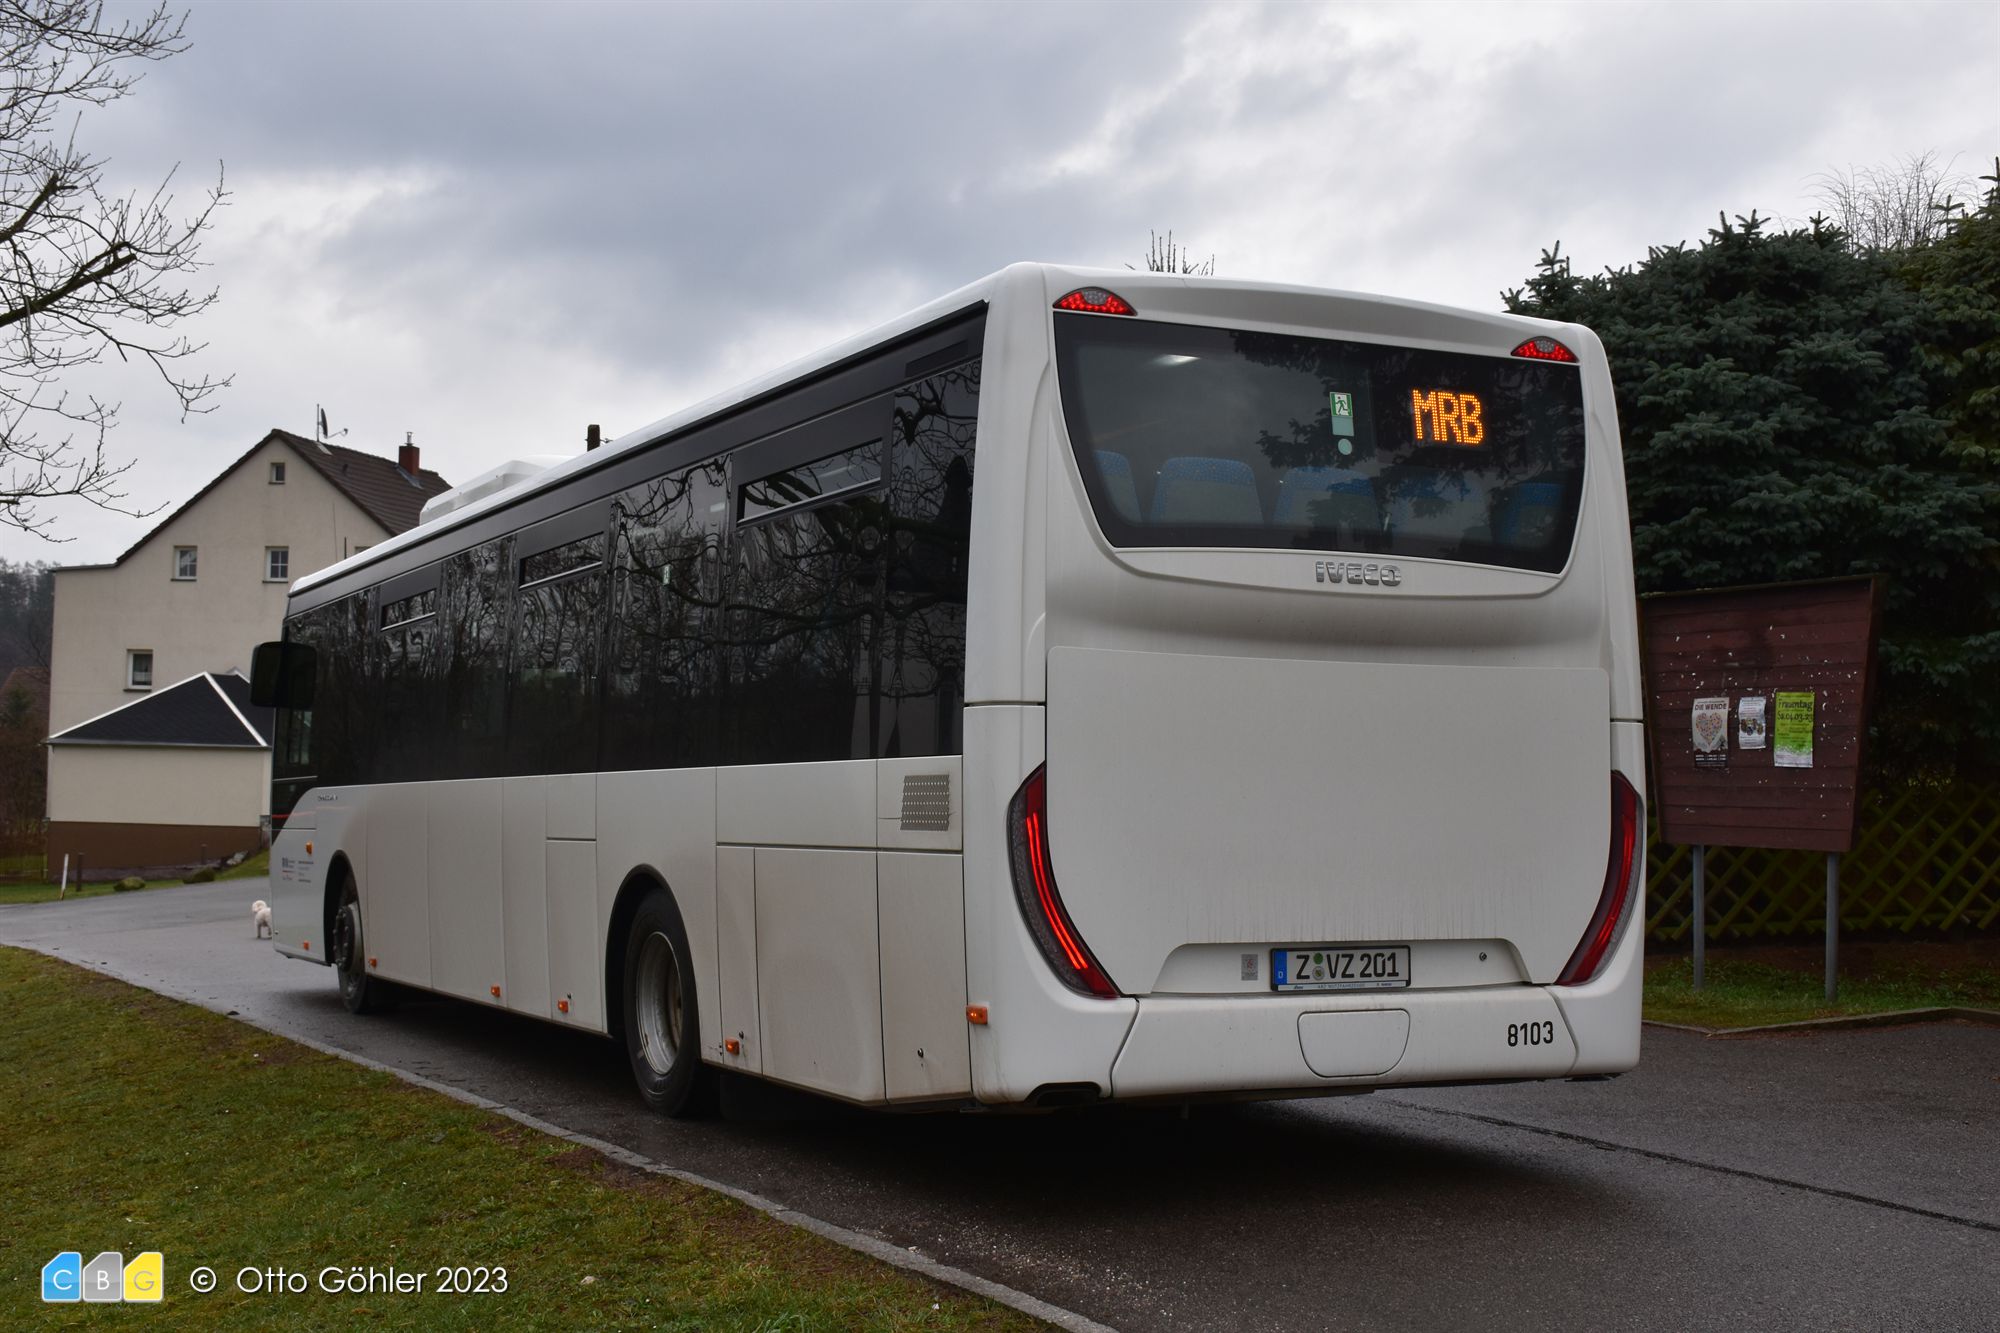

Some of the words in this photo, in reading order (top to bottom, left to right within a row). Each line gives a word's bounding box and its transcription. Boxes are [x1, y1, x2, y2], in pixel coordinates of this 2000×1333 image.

[1412, 389, 1483, 444] MRB
[1315, 560, 1401, 587] IVECO
[1705, 702, 1727, 710] WENDE
[1277, 970, 1284, 979] D
[1296, 954, 1310, 980] Z
[1326, 953, 1355, 979] VZ
[1360, 952, 1399, 978] 201
[1508, 1021, 1554, 1047] 8103
